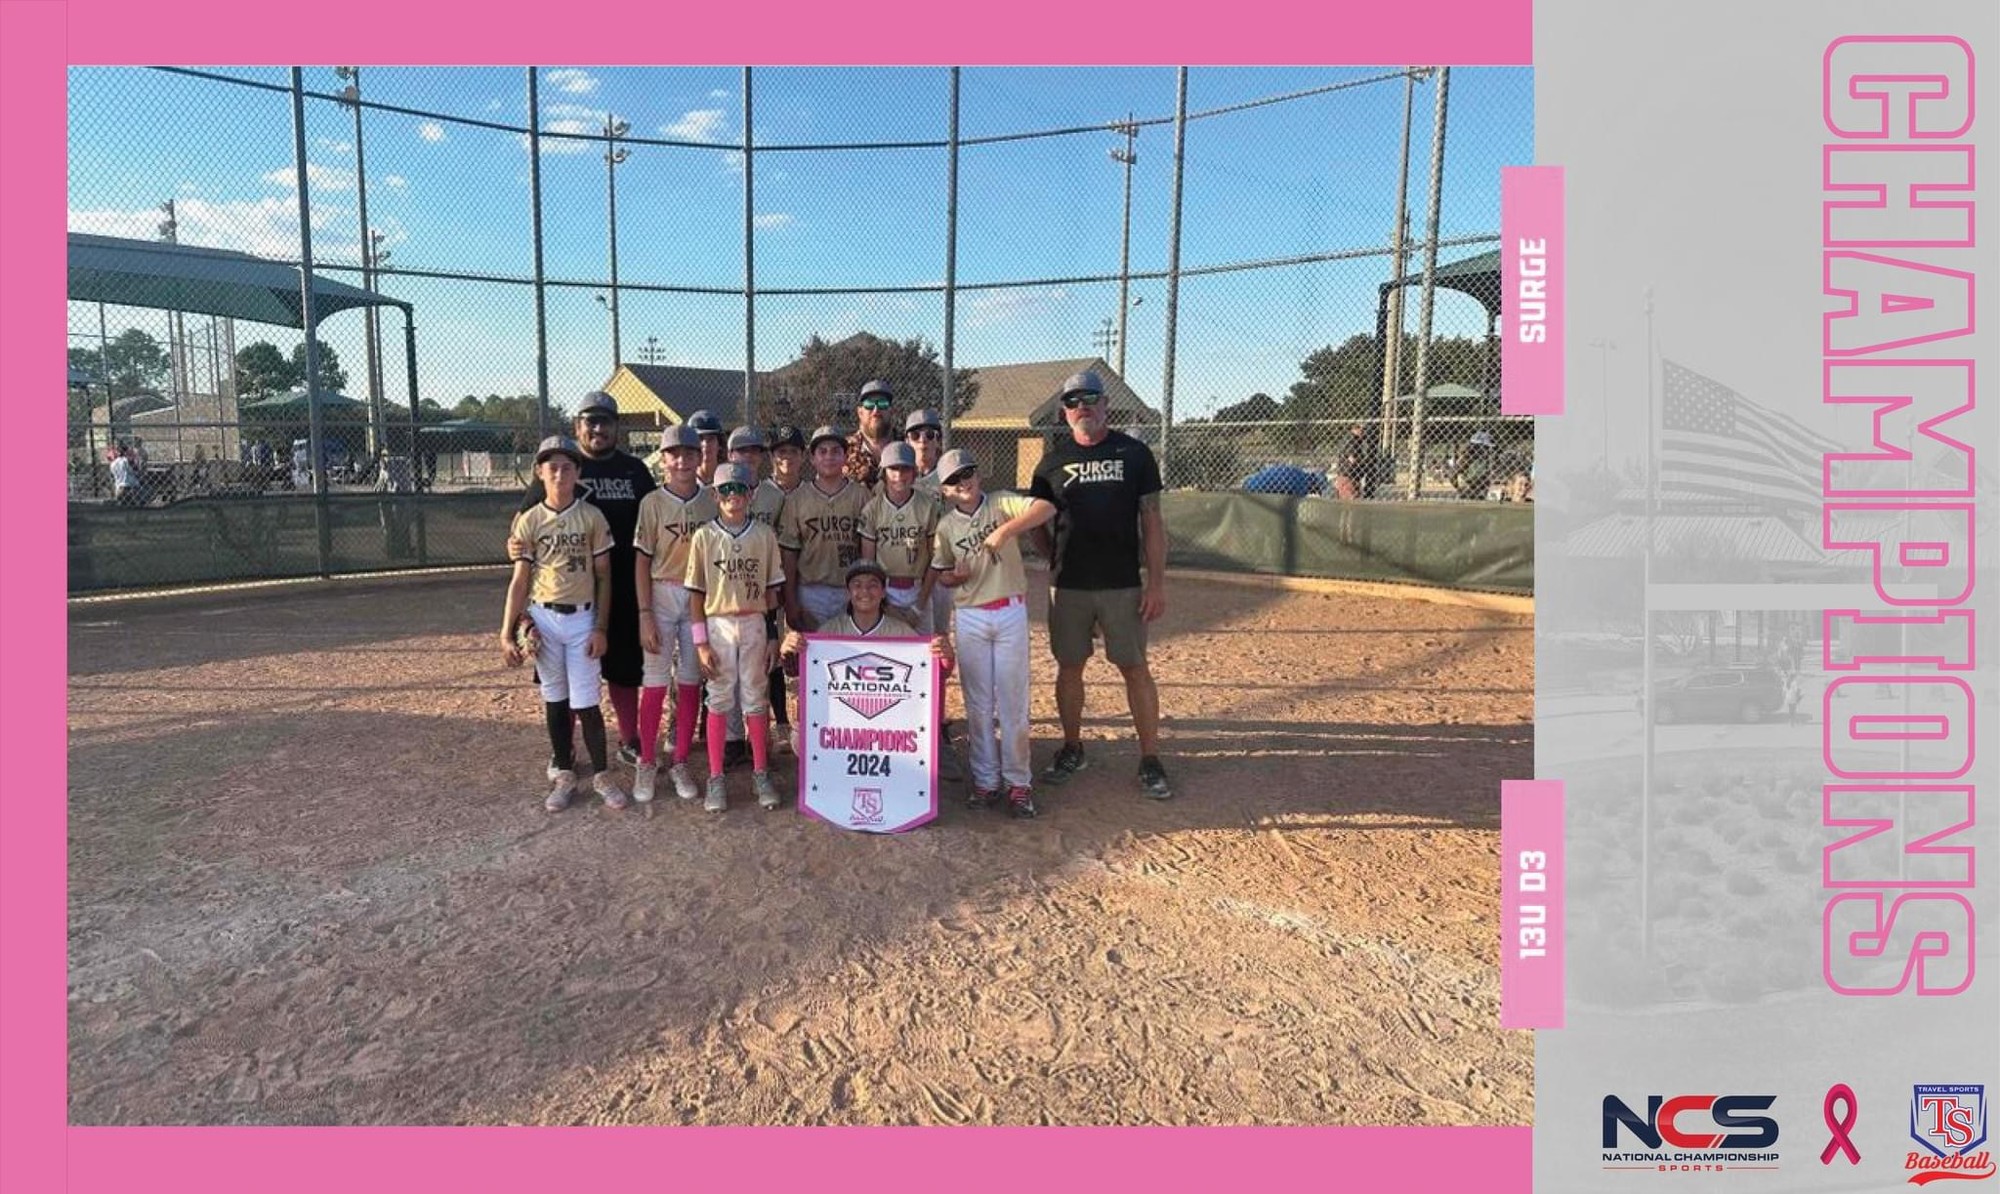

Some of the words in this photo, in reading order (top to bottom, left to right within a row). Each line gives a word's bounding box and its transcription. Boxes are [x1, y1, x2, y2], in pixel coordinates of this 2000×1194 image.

[1063, 459, 1124, 487] SURGE
[845, 665, 894, 681] NCS
[828, 681, 912, 692] NATIONAL
[819, 726, 918, 753] CHAMPIONS
[846, 753, 891, 777] 2024
